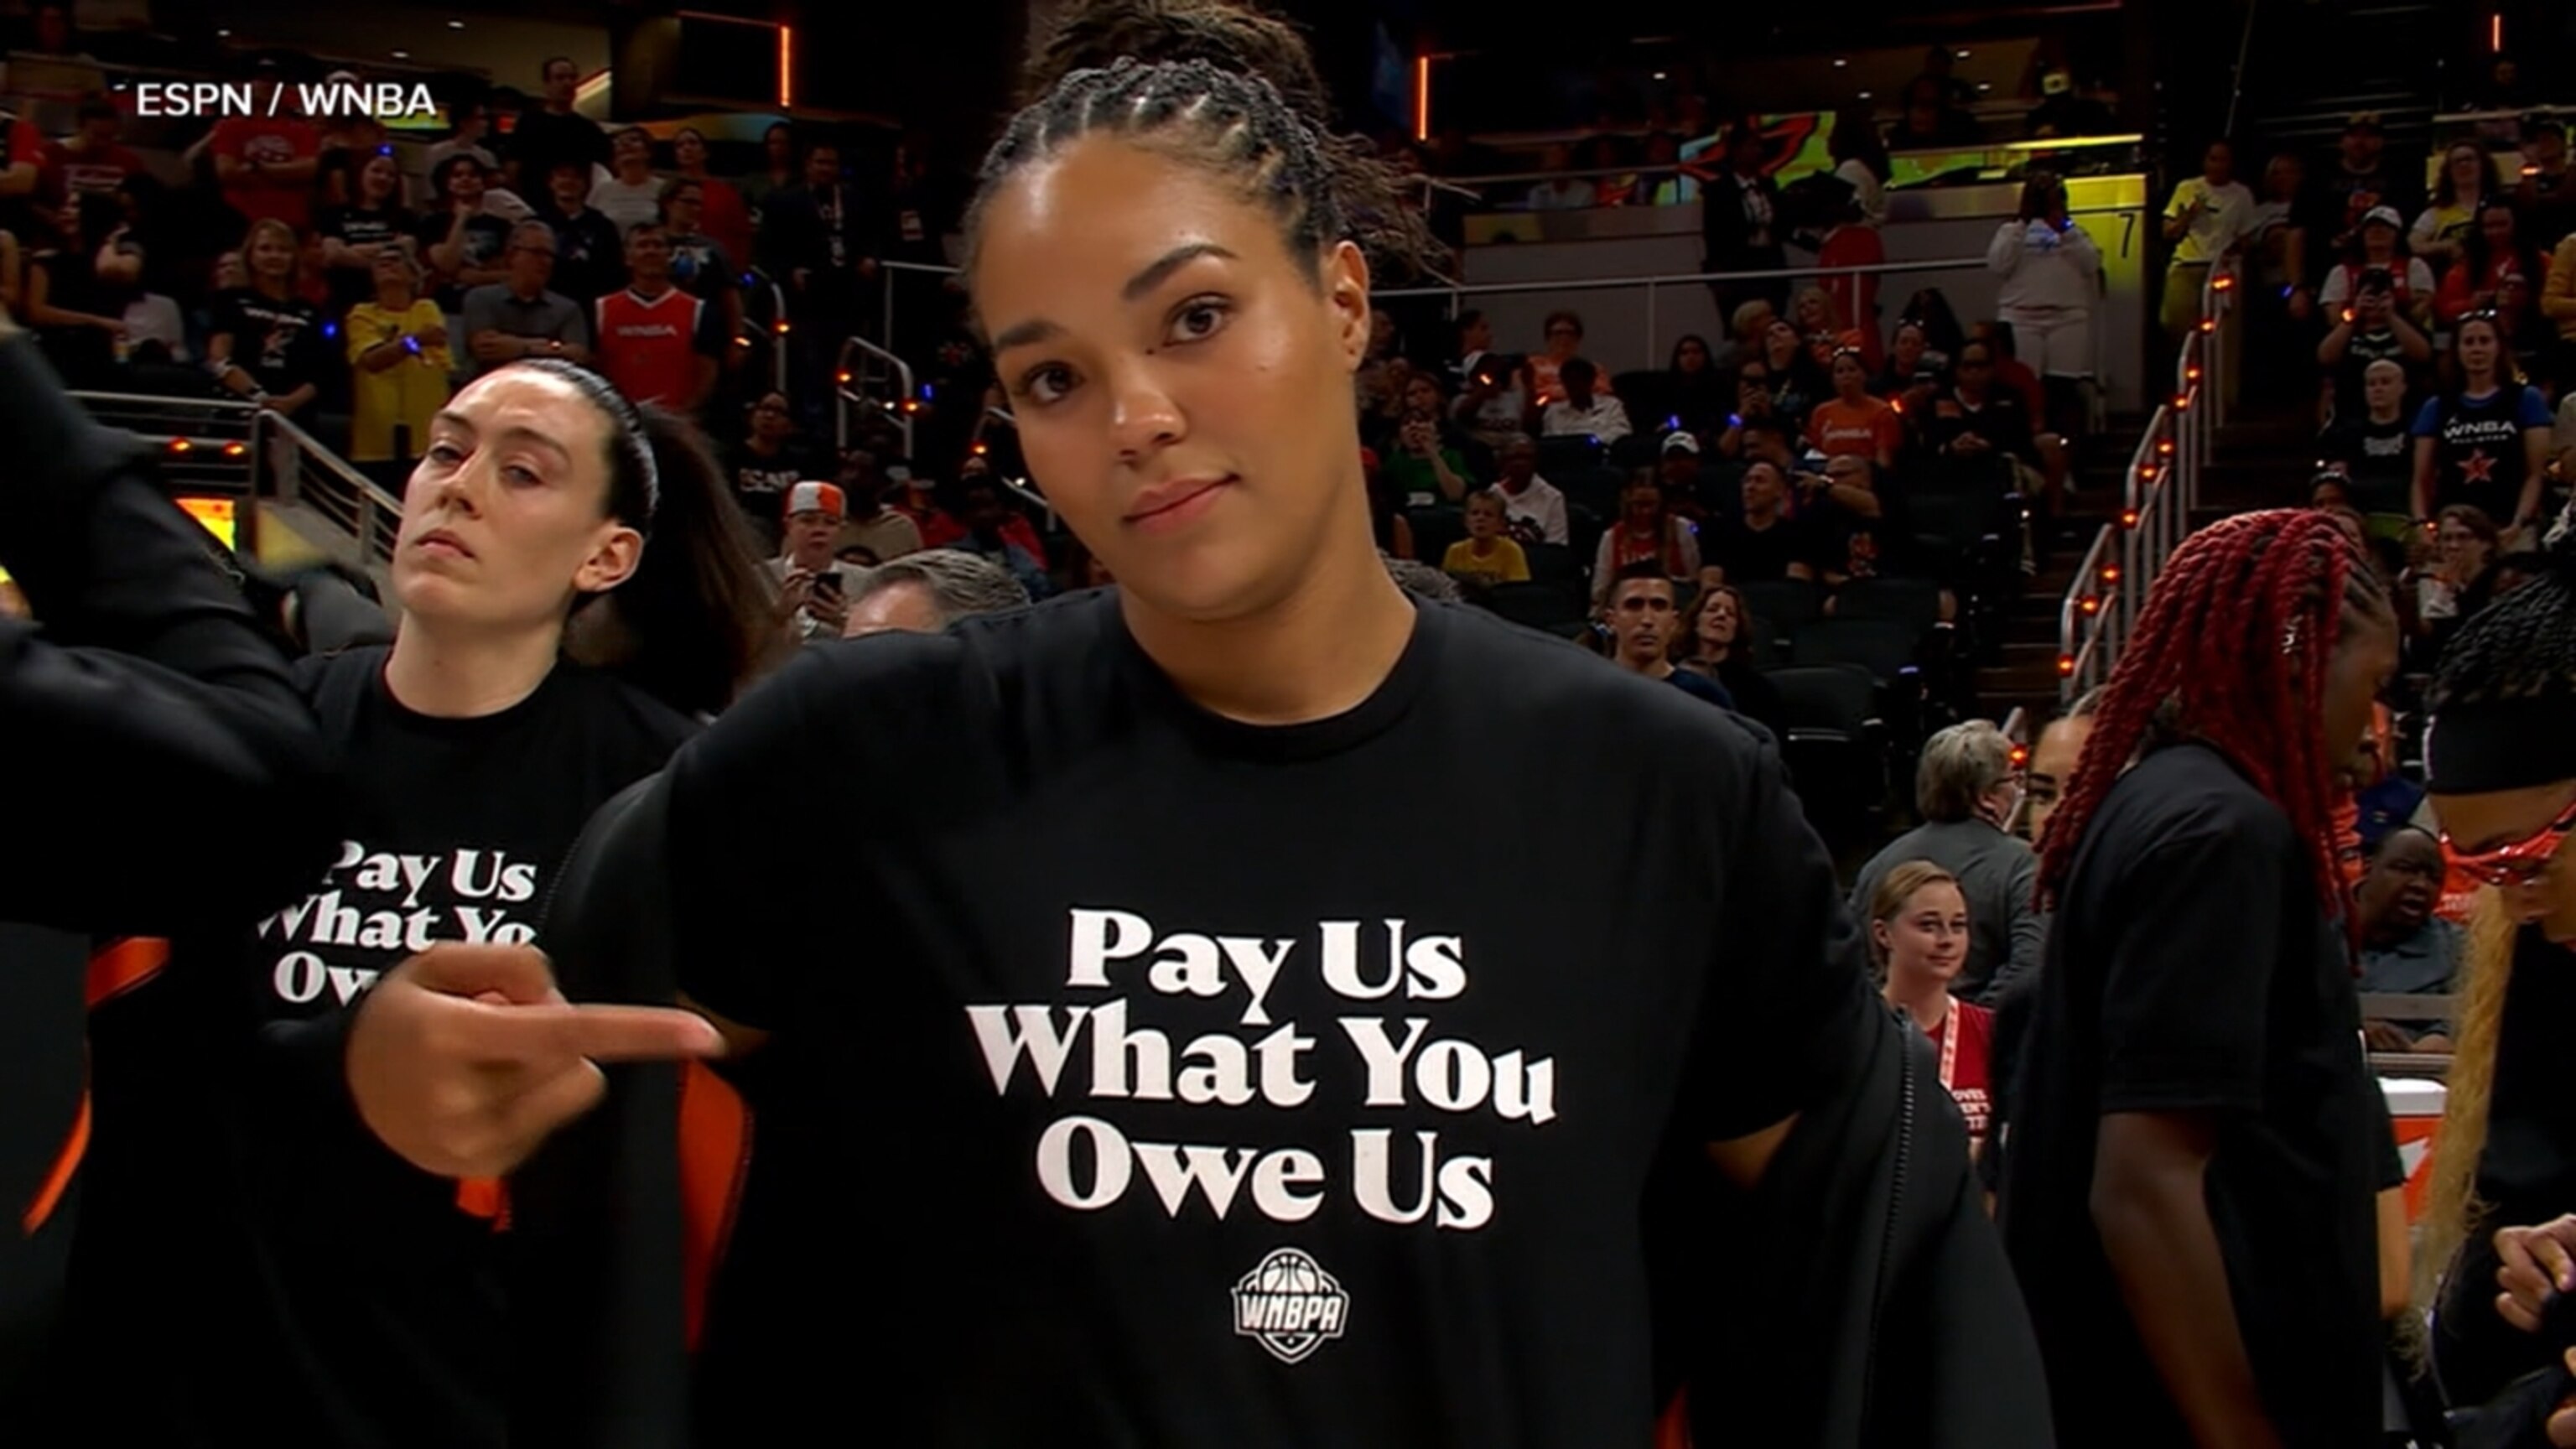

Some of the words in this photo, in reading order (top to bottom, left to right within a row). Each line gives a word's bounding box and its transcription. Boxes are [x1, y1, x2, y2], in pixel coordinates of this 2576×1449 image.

[2119, 212, 2136, 258] 7
[2442, 419, 2518, 440] WNBA
[451, 849, 538, 901] Us
[454, 906, 538, 946] Yo
[274, 951, 379, 1007] Ow
[1067, 908, 1296, 1026] Pay
[1319, 918, 1467, 1000] Us
[965, 998, 1317, 1108] What
[1337, 1017, 1558, 1126] You
[1036, 1116, 1326, 1223] Owe
[1350, 1129, 1494, 1230] Us
[1241, 1294, 1343, 1332] WNBPA
